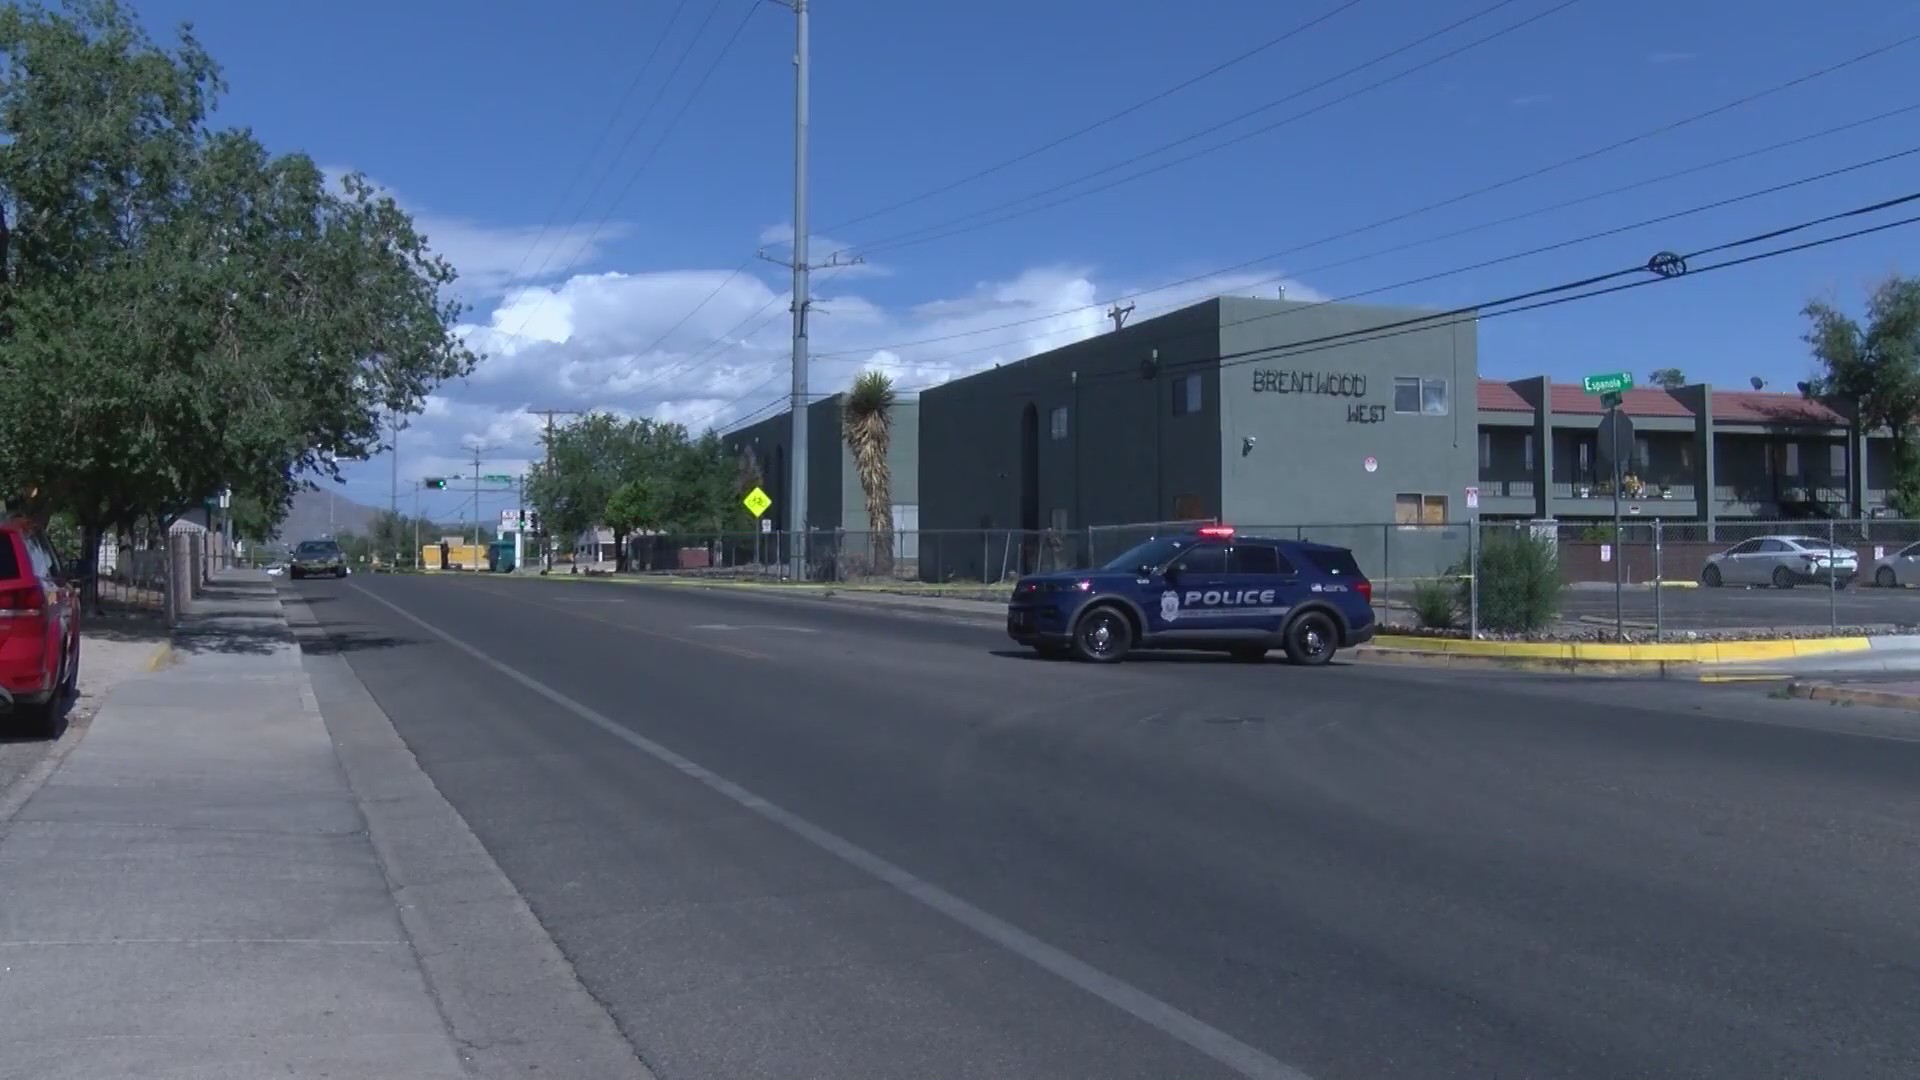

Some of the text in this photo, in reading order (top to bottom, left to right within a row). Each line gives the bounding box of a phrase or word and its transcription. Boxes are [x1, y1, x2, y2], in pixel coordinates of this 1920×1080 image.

[1252, 369, 1366, 398] BRENTWOOD
[1346, 404, 1386, 423] WEST
[1184, 589, 1276, 606] POLICE
